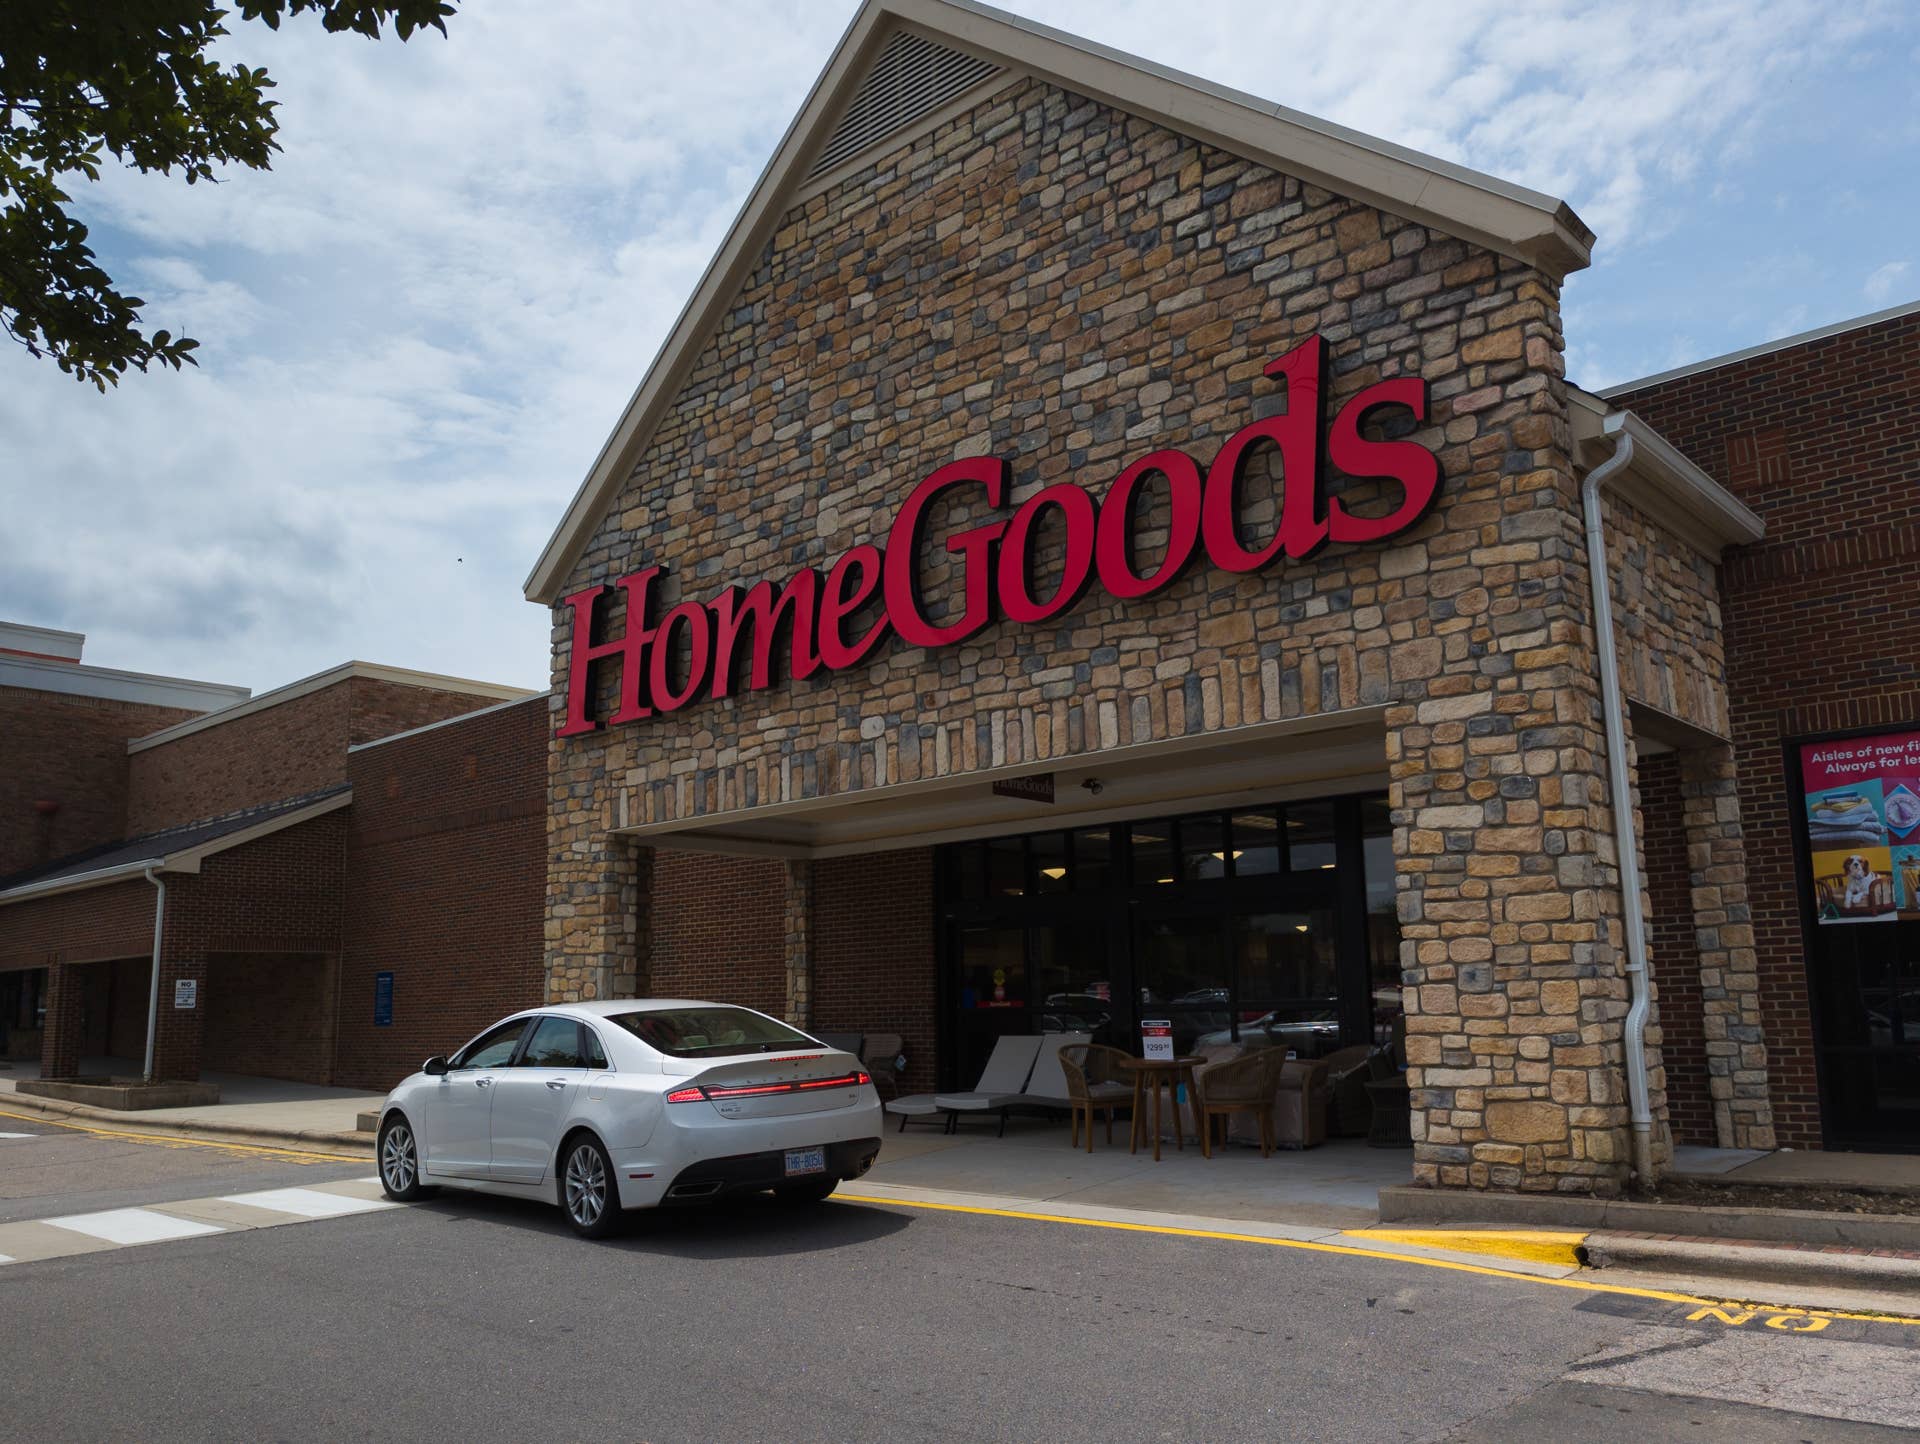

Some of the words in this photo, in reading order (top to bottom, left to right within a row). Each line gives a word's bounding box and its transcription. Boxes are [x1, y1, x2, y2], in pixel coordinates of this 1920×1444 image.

[556, 333, 1442, 738] HomeGoods
[1812, 750, 1853, 763] Aisles
[1857, 745, 1872, 757] of
[1876, 745, 1904, 755] new
[1907, 740, 1920, 751] fi
[1826, 761, 1876, 774] Always
[1880, 757, 1901, 767] for
[1686, 1307, 1831, 1332] NO
